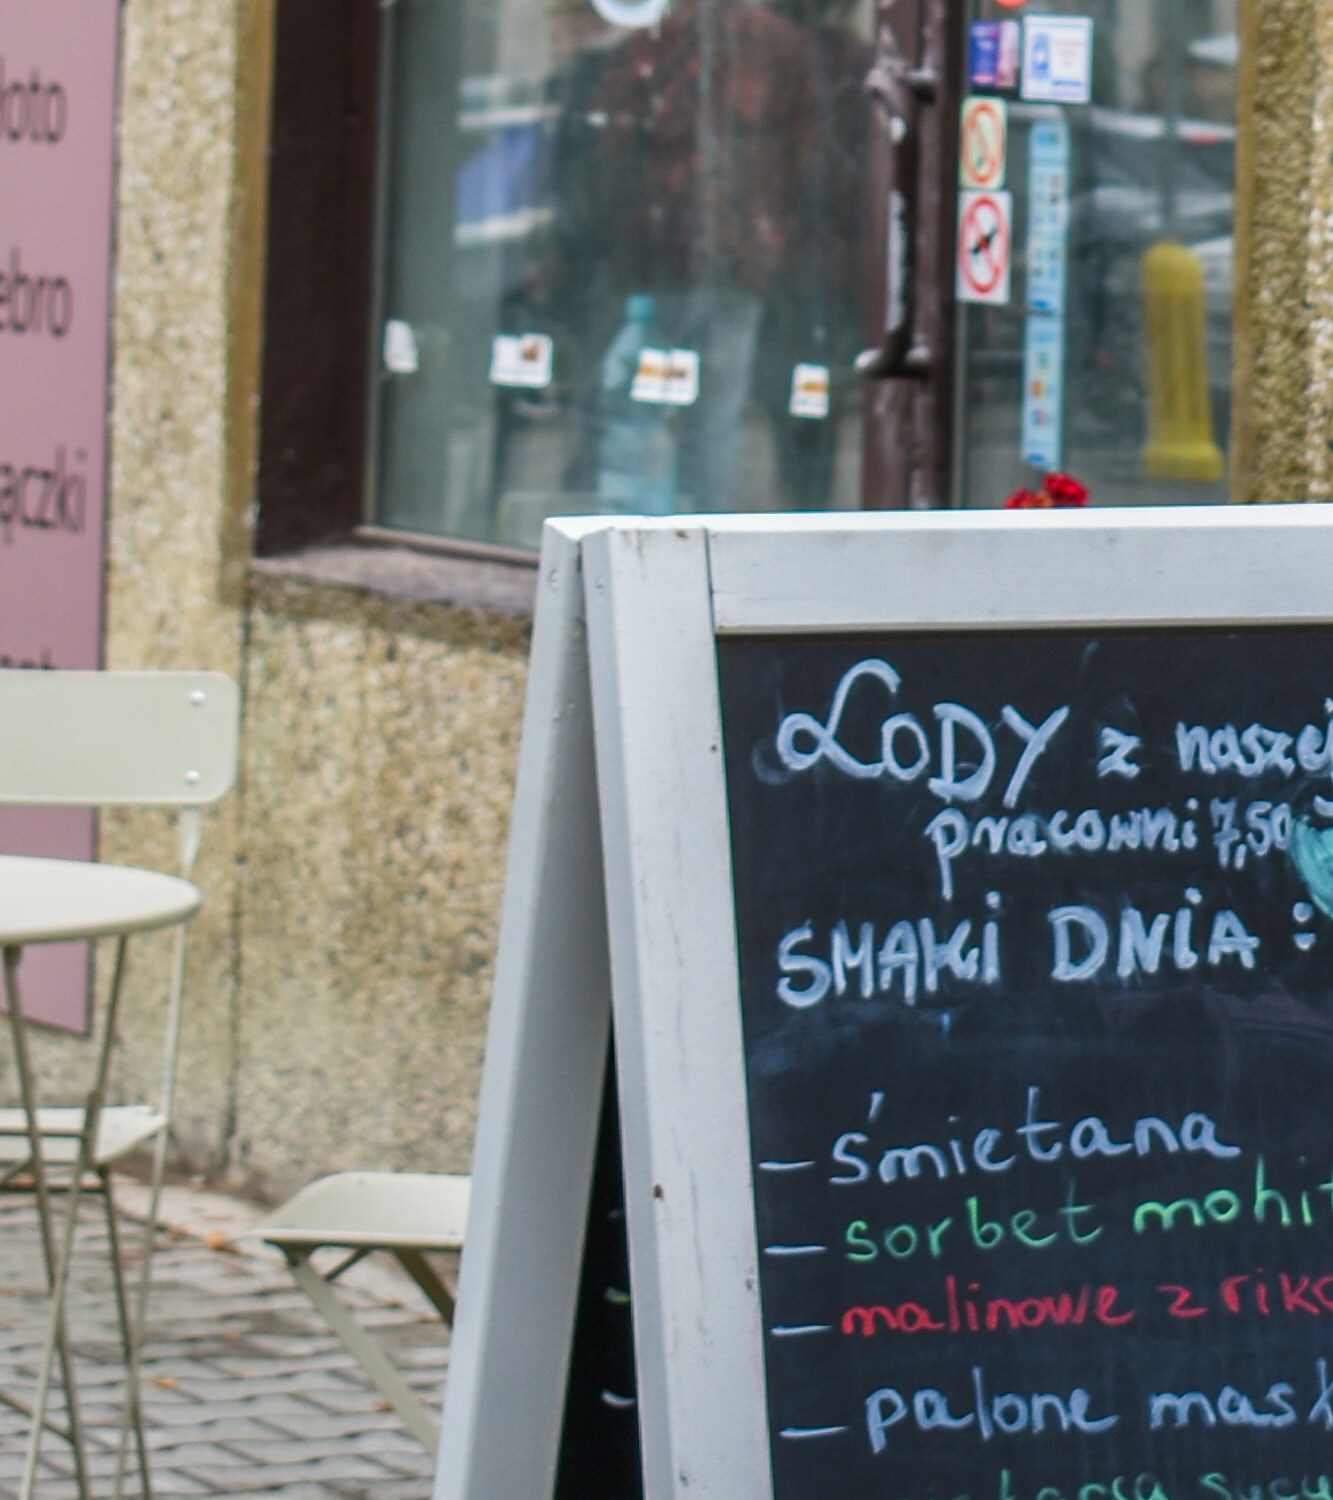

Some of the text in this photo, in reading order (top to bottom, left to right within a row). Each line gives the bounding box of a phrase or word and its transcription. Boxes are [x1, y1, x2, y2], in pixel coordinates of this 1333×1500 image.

[1099, 726, 1141, 778] z
[924, 796, 1200, 900] pracowni
[829, 1084, 1241, 1185] śmietana
[845, 1177, 1102, 1262] sorbet
[841, 1275, 1134, 1337] malinowe
[1157, 1283, 1207, 1318] z
[866, 1365, 1122, 1454] palone
